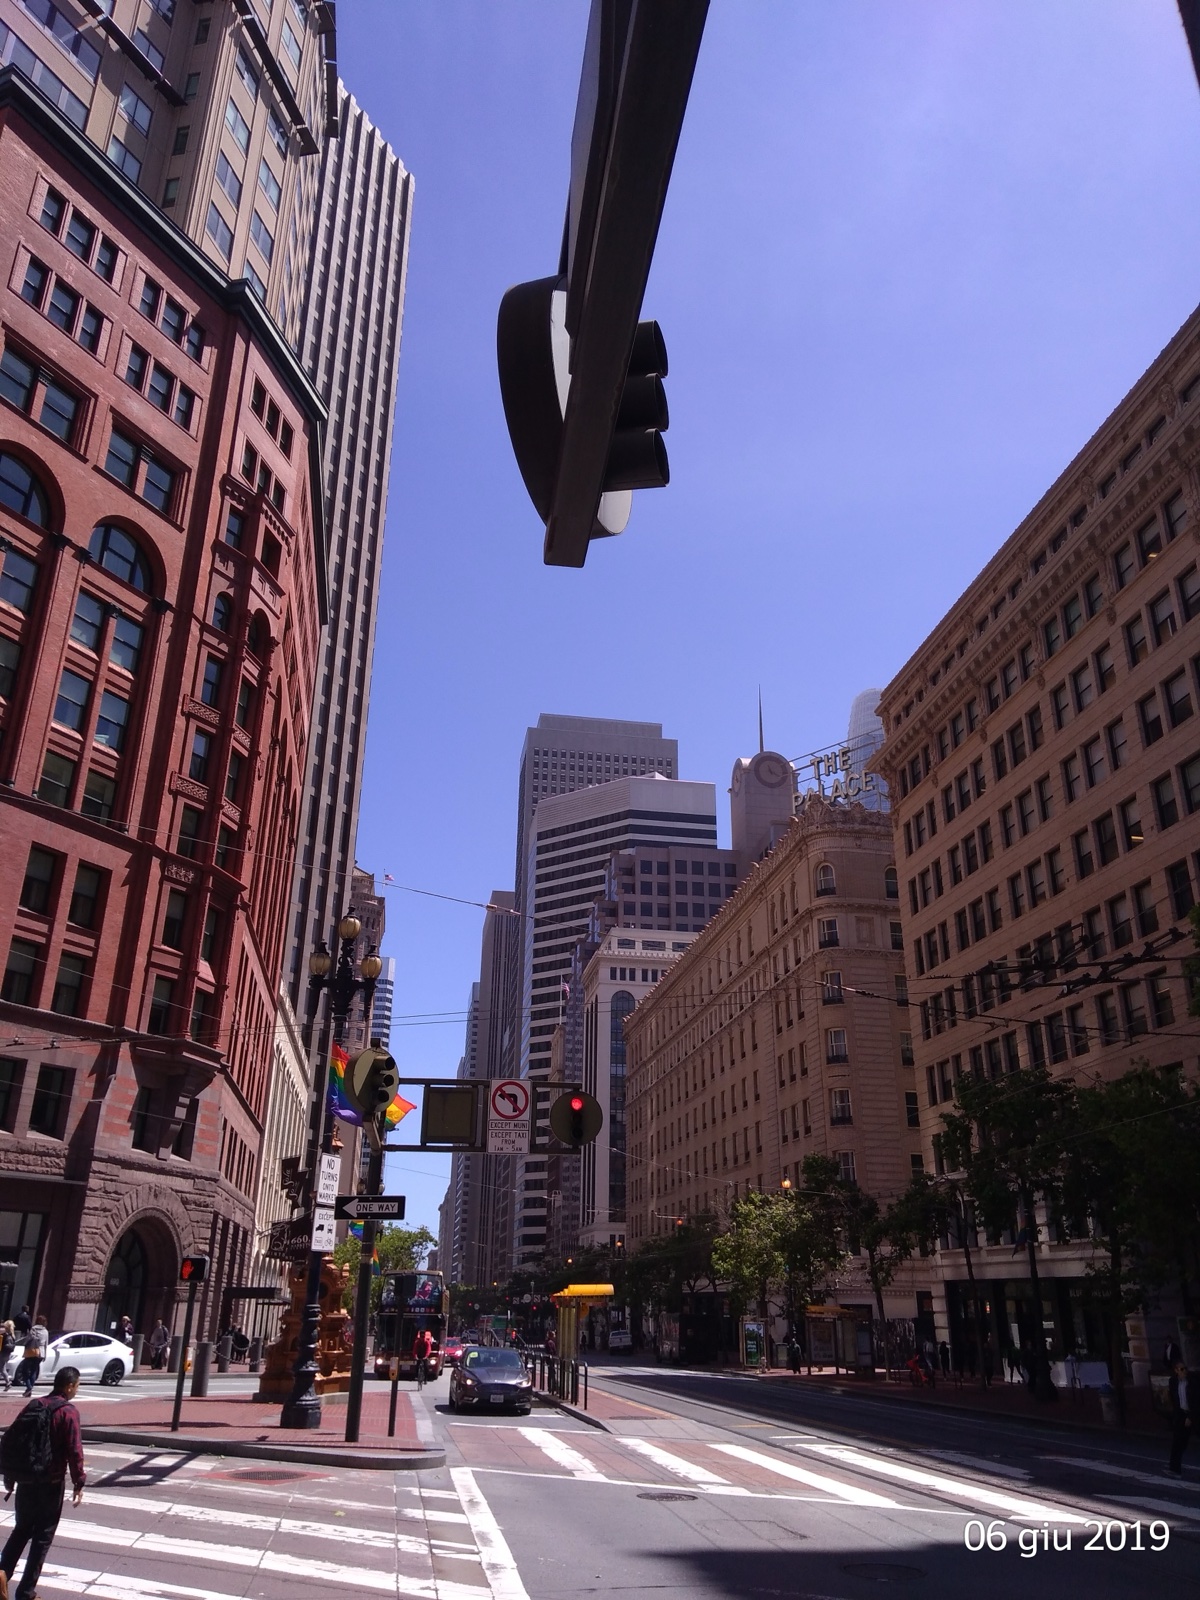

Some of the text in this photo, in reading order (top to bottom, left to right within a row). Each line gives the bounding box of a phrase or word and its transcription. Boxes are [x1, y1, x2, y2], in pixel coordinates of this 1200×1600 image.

[810, 747, 851, 780] THE
[490, 1121, 511, 1129] EXCEPT
[490, 1131, 511, 1139] EXCEPT
[327, 1158, 335, 1170] NO
[321, 1171, 338, 1182] TURNS
[322, 1182, 334, 1192] ONTO
[356, 1203, 396, 1212] ONE WAY
[318, 1212, 334, 1221] EXCEPT
